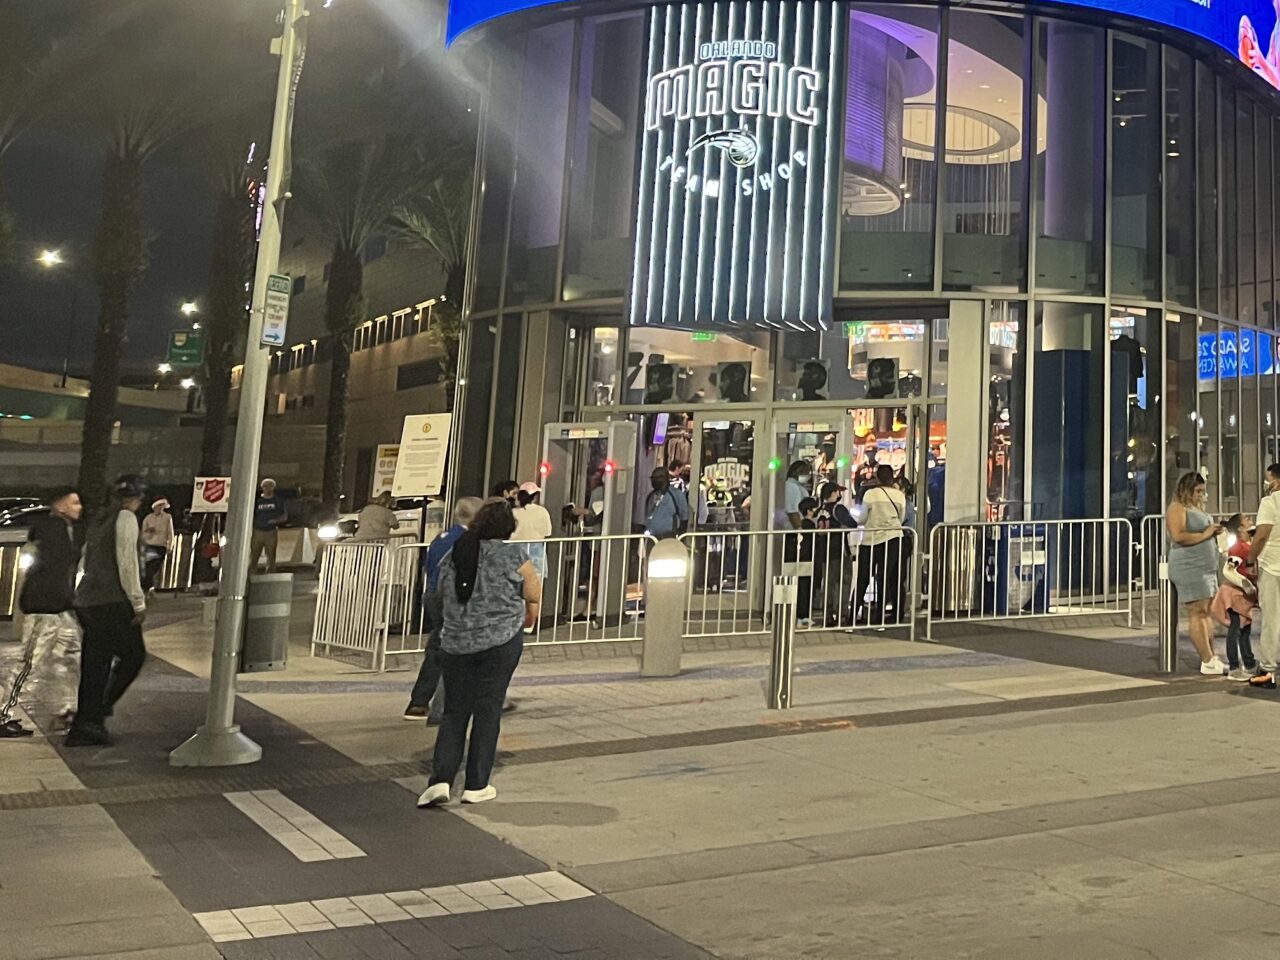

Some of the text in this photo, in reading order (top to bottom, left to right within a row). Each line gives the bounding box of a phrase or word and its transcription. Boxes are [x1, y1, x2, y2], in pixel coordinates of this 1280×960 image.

[700, 40, 776, 60] ORLANDO
[647, 60, 820, 131] MAGIC
[659, 150, 807, 198] TEAM SHOP
[704, 462, 750, 482] MAGIC
